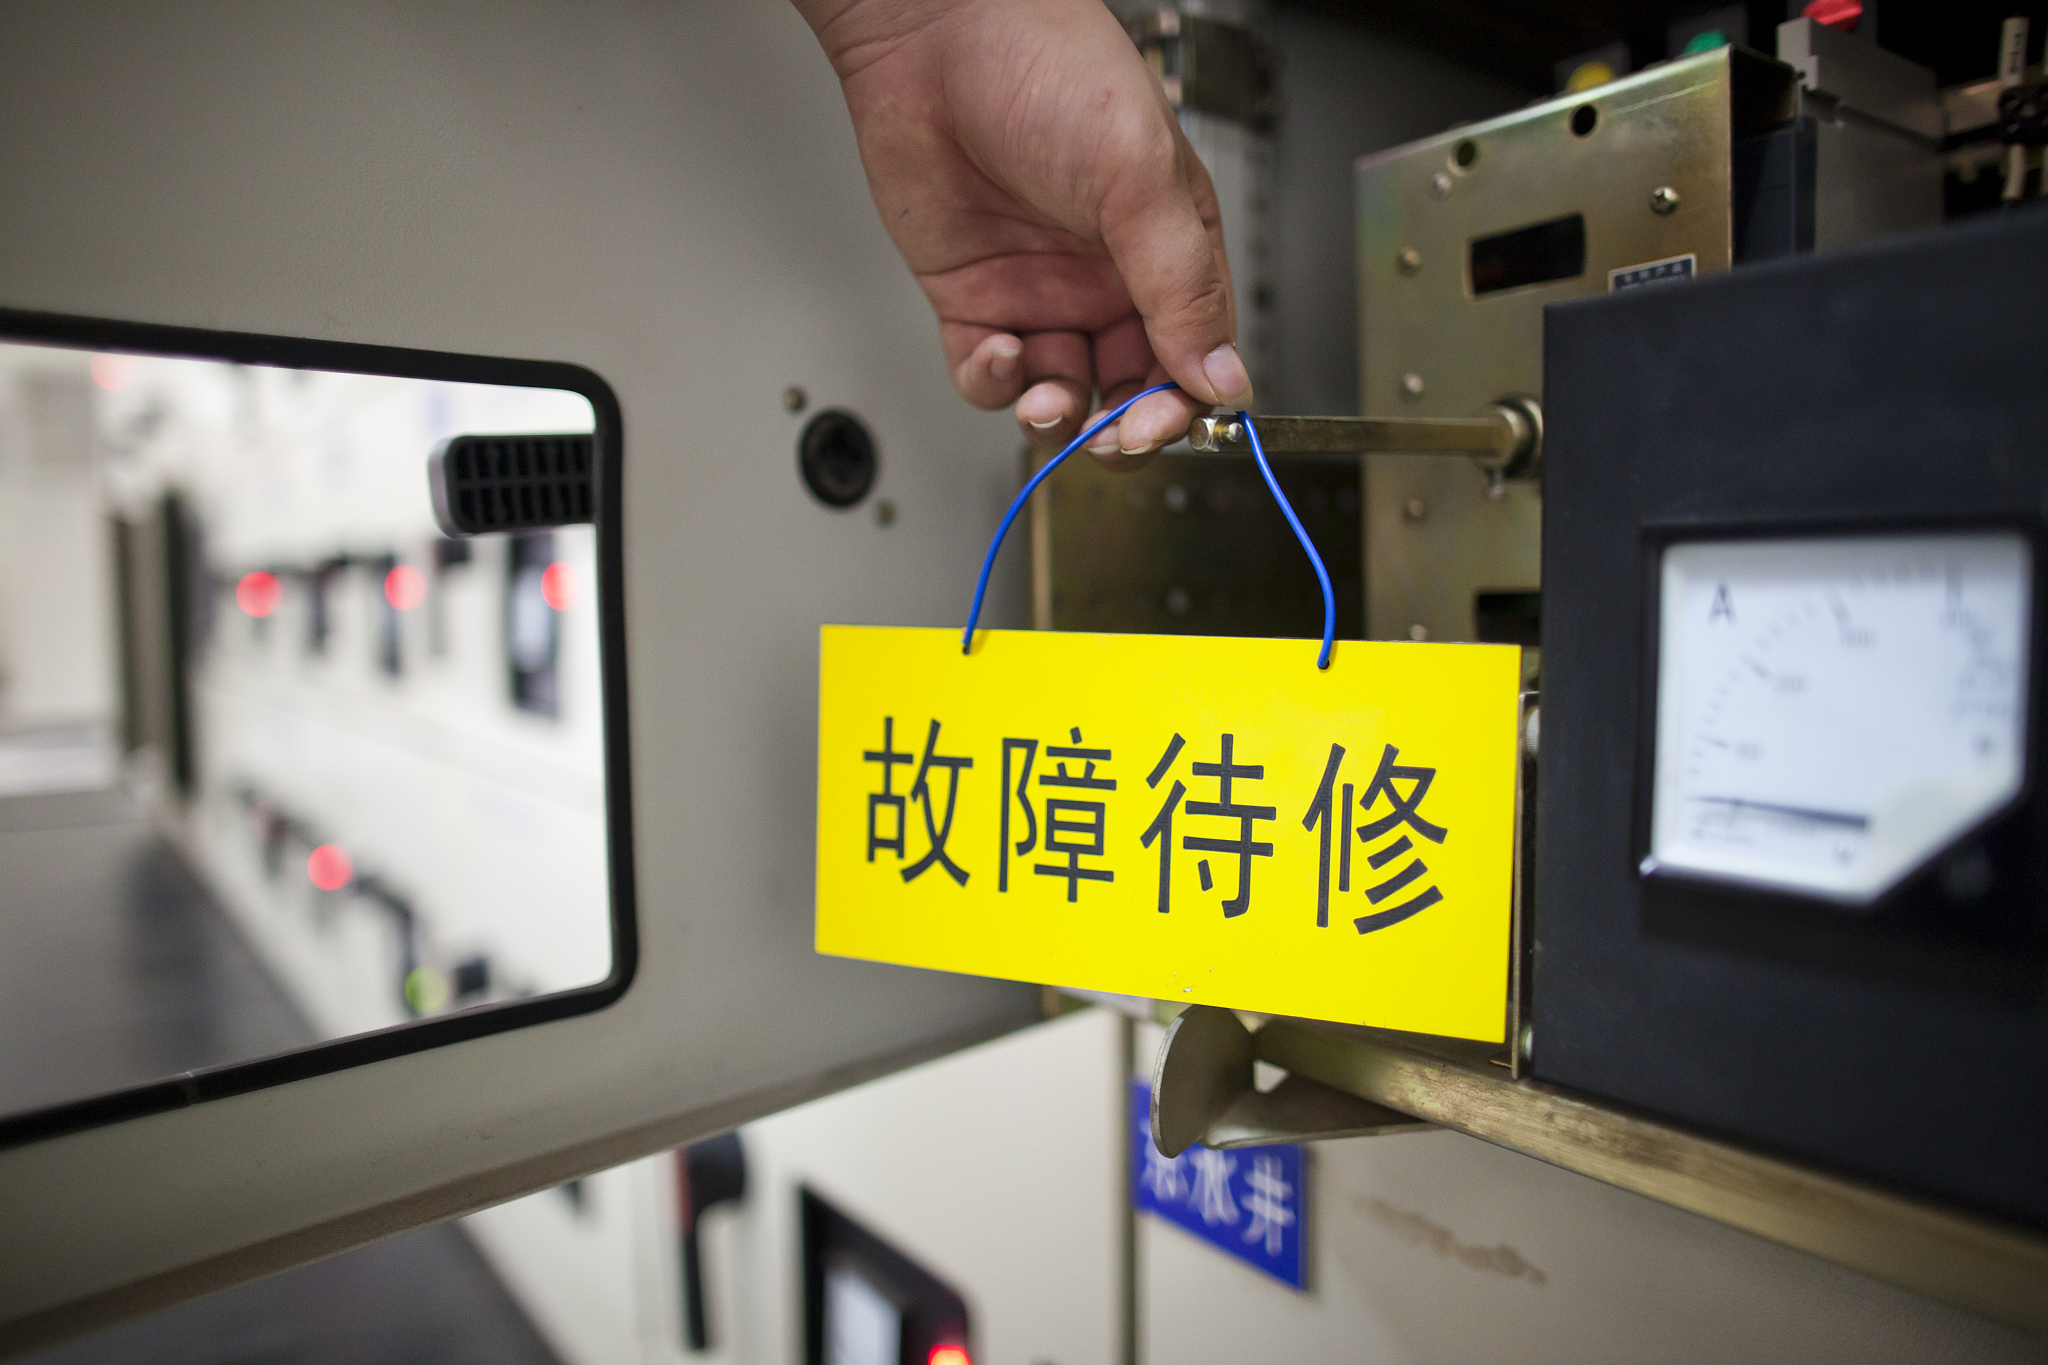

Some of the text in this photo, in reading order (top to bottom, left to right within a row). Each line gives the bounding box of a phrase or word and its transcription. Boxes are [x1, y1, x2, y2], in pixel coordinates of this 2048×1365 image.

[1709, 583, 1736, 623] A
[863, 716, 1448, 935] 故障待修
